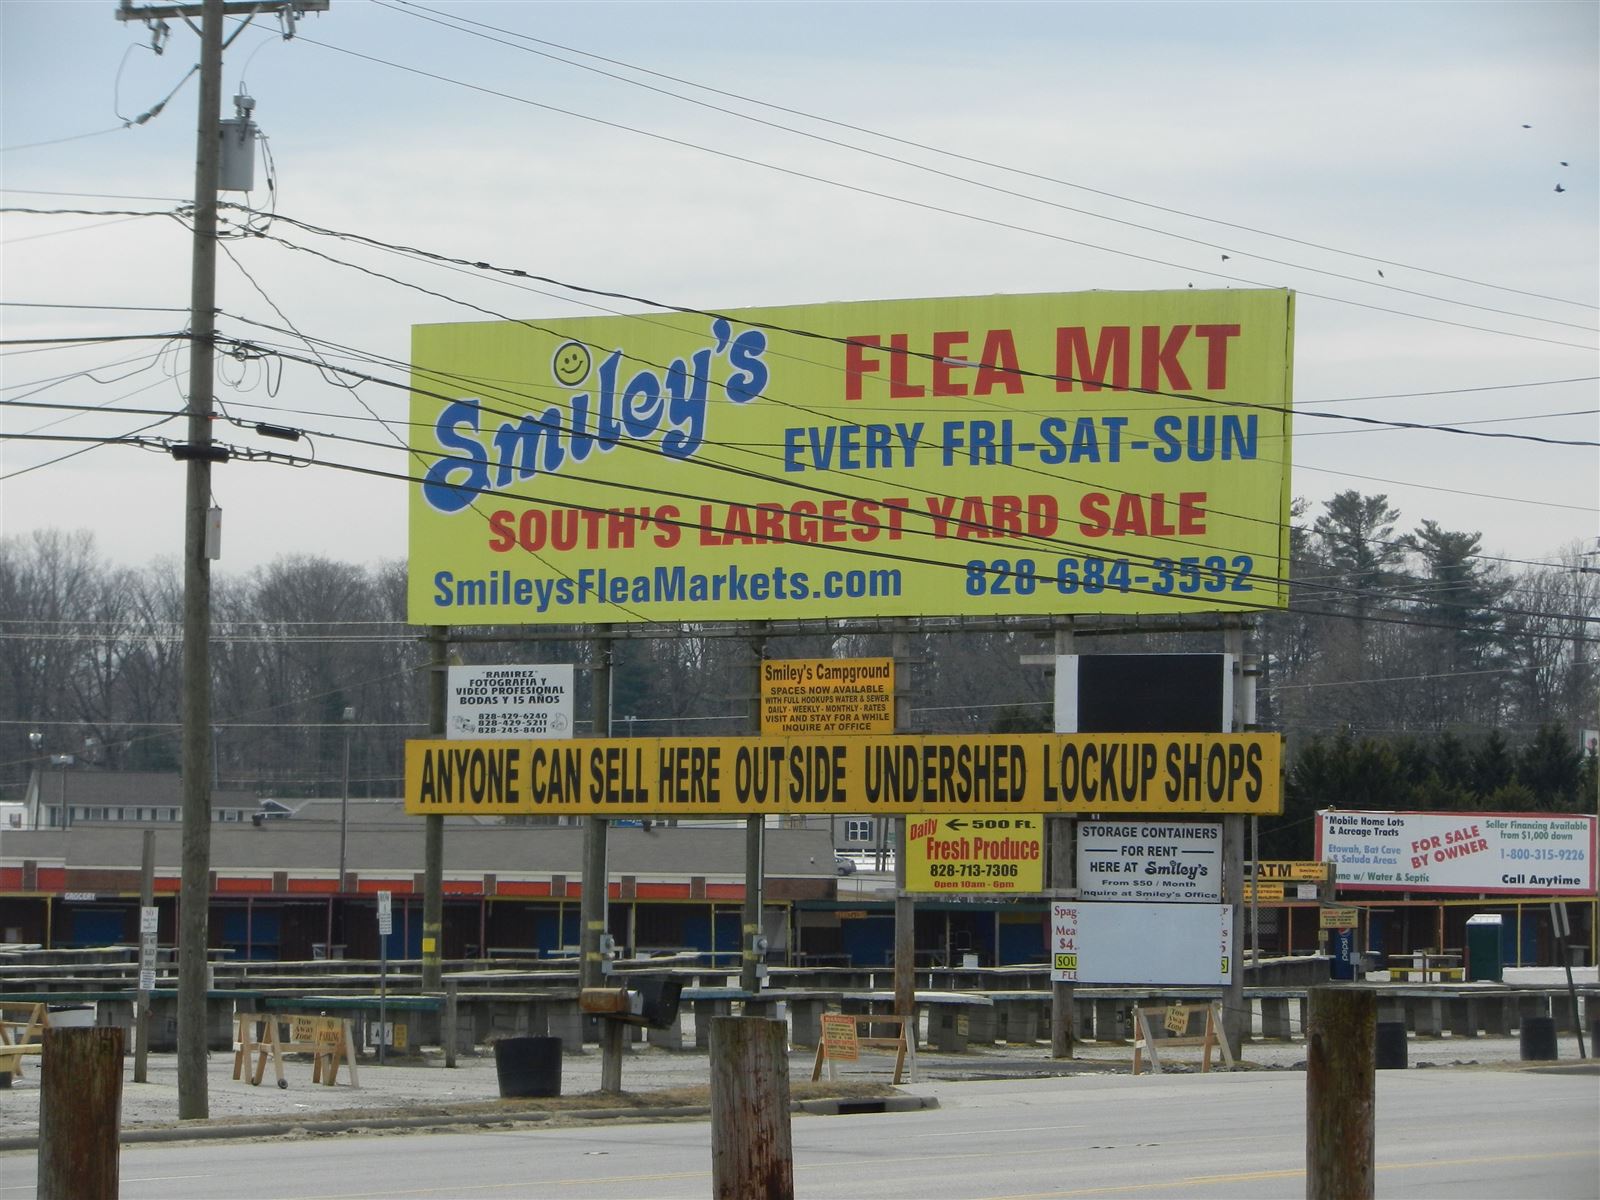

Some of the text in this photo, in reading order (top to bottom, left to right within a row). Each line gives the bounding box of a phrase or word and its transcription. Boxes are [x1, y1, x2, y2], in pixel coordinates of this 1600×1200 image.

[846, 324, 1241, 400] FLEA MKT
[423, 317, 768, 512] Smiley's
[784, 414, 1259, 472] EVERY FRI-SAT-SUN
[488, 491, 1208, 552] SOUTH'S LARGEST YARD SALE
[434, 555, 1254, 613] SmileysFleaMarkets.com 828-684-3532
[765, 662, 890, 684] Smiley's Campground
[469, 678, 537, 687] FOTOGRAFIA
[456, 686, 565, 695] VIDEO PROFESIONAL
[770, 685, 884, 695] SPACES NOW AVAILABLE
[460, 694, 560, 704] BODAS Y 15 AÑOS
[783, 696, 799, 704] FULL
[801, 695, 833, 703] HOOKUPS
[835, 695, 858, 703] WATER
[866, 694, 890, 702] SEWER
[792, 705, 820, 713] WEEKLY
[825, 704, 858, 712] MONTHLY
[810, 714, 832, 722] STAY
[862, 713, 889, 721] WHILE
[782, 723, 821, 731] INQUIRE
[824, 723, 836, 731] AT
[420, 742, 1263, 805] ANYONE CAN SELL HERE OUTSIDE UNDERSHED LOCKUP SHOPS
[1361, 817, 1384, 826] Home
[1387, 818, 1405, 827] Lots
[1486, 820, 1587, 831] Seller Financing Available
[910, 818, 1036, 841] Daily 500 Ft.
[1082, 826, 1218, 839] STORAGE CONTAINERS
[1338, 827, 1371, 837] Acreage
[1374, 828, 1399, 836] Tracts
[1500, 831, 1573, 840] from $1,000 down
[1411, 825, 1480, 853] FOR SALE
[926, 837, 1040, 860] Fresh Produce
[1121, 845, 1178, 857] FOR RENT
[1364, 845, 1379, 853] Bat
[1381, 846, 1401, 854] Cave
[1411, 839, 1489, 869] BY OWNER
[1501, 848, 1585, 860] 1-800-315-9226
[1342, 855, 1371, 864] Saluda
[1372, 856, 1397, 864] Areas
[930, 864, 1018, 877] 828-713-7306
[1090, 860, 1208, 880] HERE AT Smiley's
[1257, 863, 1292, 877] ATM
[1367, 872, 1393, 880] Water
[1404, 873, 1429, 883] Septic
[1502, 874, 1581, 887] Call Anytime
[934, 881, 958, 889] Open
[1135, 890, 1181, 898] Smiley's
[1184, 891, 1218, 899] Office
